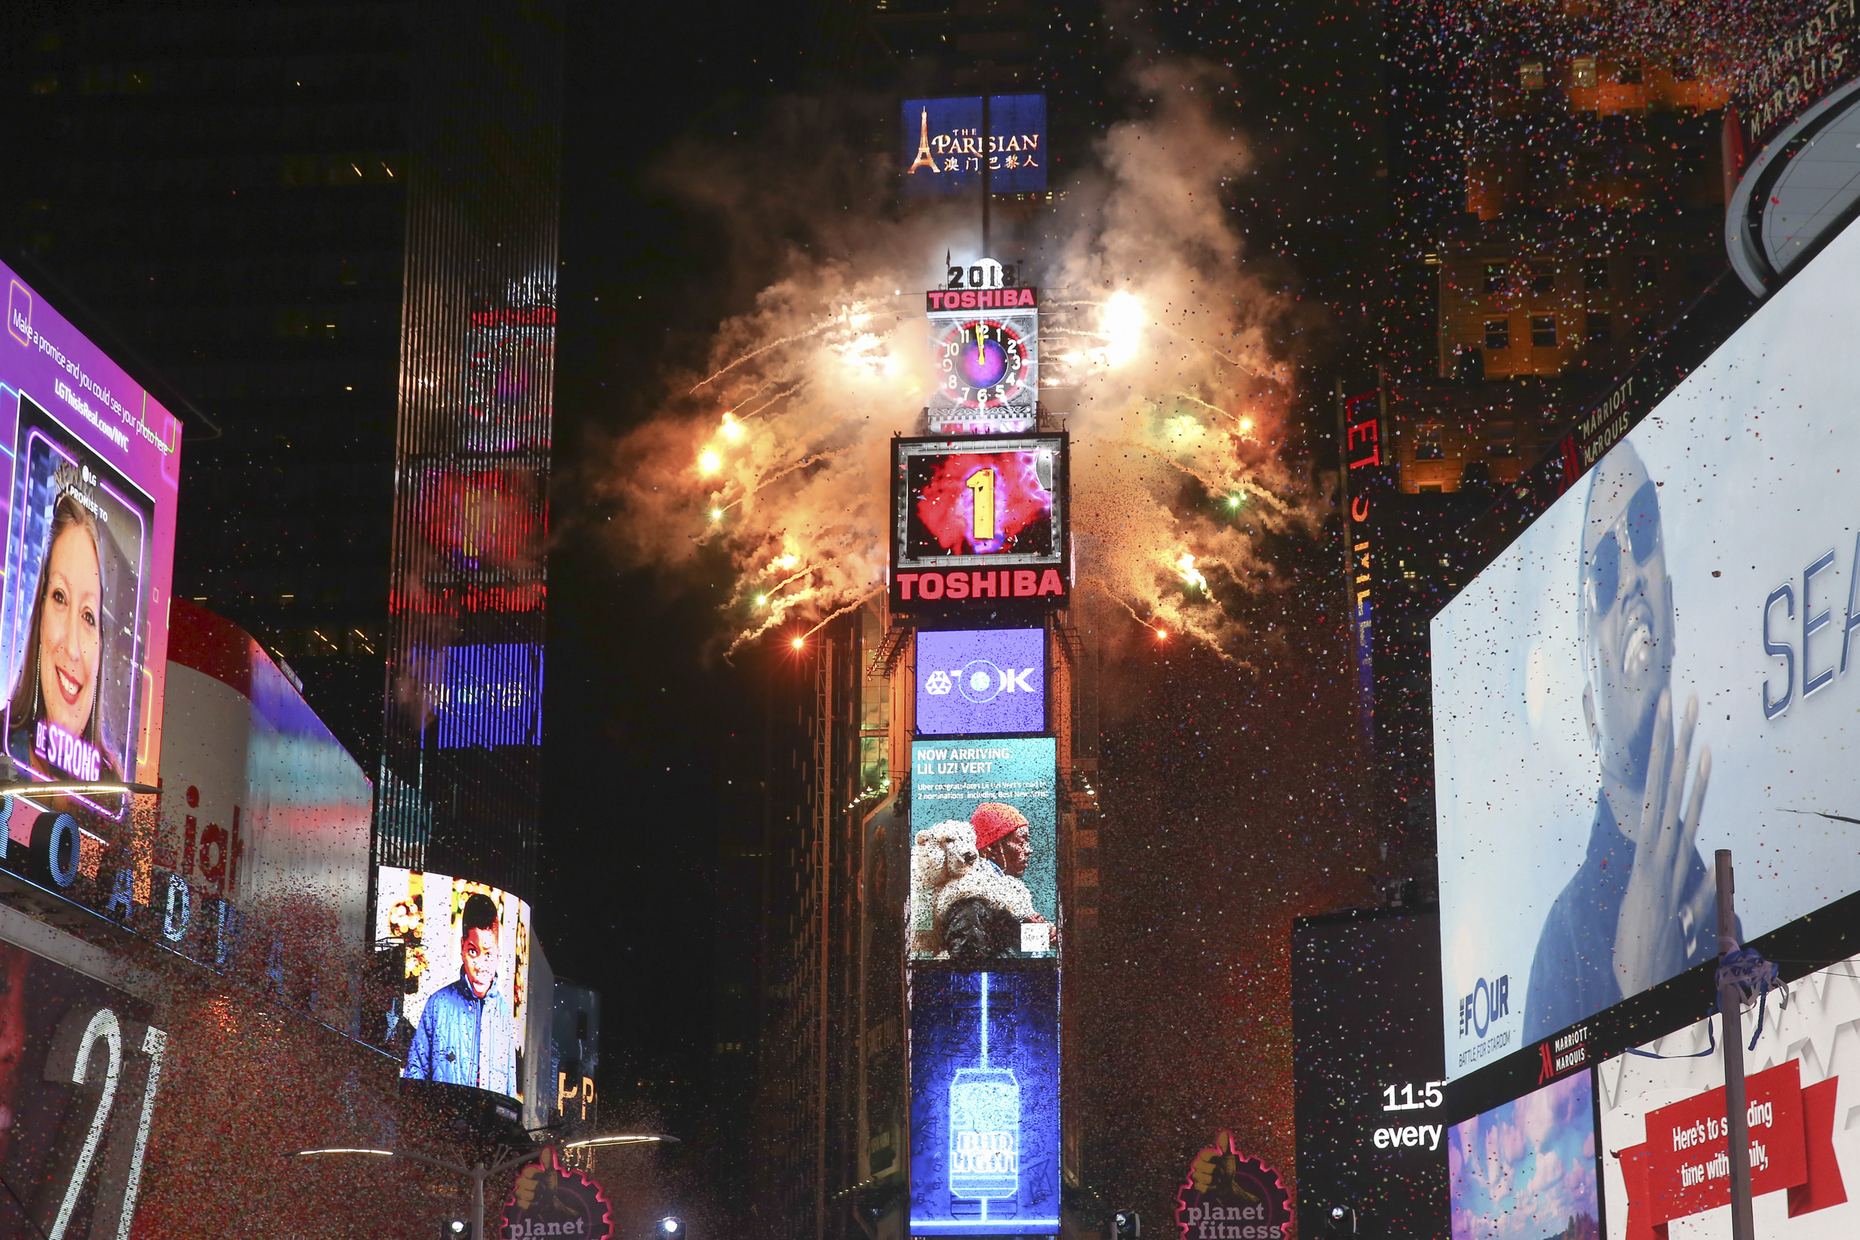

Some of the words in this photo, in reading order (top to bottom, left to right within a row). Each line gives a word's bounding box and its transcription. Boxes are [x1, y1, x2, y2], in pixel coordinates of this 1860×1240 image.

[1750, 42, 1844, 143] MARQUIS
[952, 128, 977, 136] THE
[931, 134, 1039, 158] PARISIAN
[944, 154, 1039, 172] 澳门巴黎人
[948, 265, 1016, 288] 2018
[928, 289, 1035, 309] TOSHIBA
[13, 309, 35, 341] Make
[33, 331, 39, 345] a
[38, 336, 66, 369] promise
[66, 358, 80, 380] and
[79, 371, 93, 391] you
[92, 382, 111, 407] could
[110, 397, 122, 416] see
[121, 407, 137, 428] your
[1583, 377, 1633, 440] MARRIOTT
[1584, 411, 1631, 466] MARQUIS
[88, 471, 97, 487] LG
[70, 485, 98, 517] PROMISE
[99, 507, 108, 523] TO
[966, 468, 995, 539] 1
[896, 569, 1063, 600] TOSHIBA
[36, 722, 48, 752] BE
[47, 725, 100, 782] STRONG
[917, 750, 947, 761] NOW
[917, 763, 935, 775] LIL
[961, 762, 992, 774] VERT
[1465, 974, 1509, 1038] FOUR
[1555, 1026, 1588, 1053] MARRIOTT
[1555, 1047, 1586, 1071] MARQUIS
[1373, 1124, 1443, 1151] every
[1672, 1119, 1706, 1152] Here's
[1707, 1117, 1719, 1140] to
[1681, 1162, 1705, 1187] time
[1706, 1150, 1730, 1180] with
[1187, 1202, 1265, 1226] planet
[510, 1218, 585, 1240] planet
[1199, 1221, 1281, 1240] fitness
